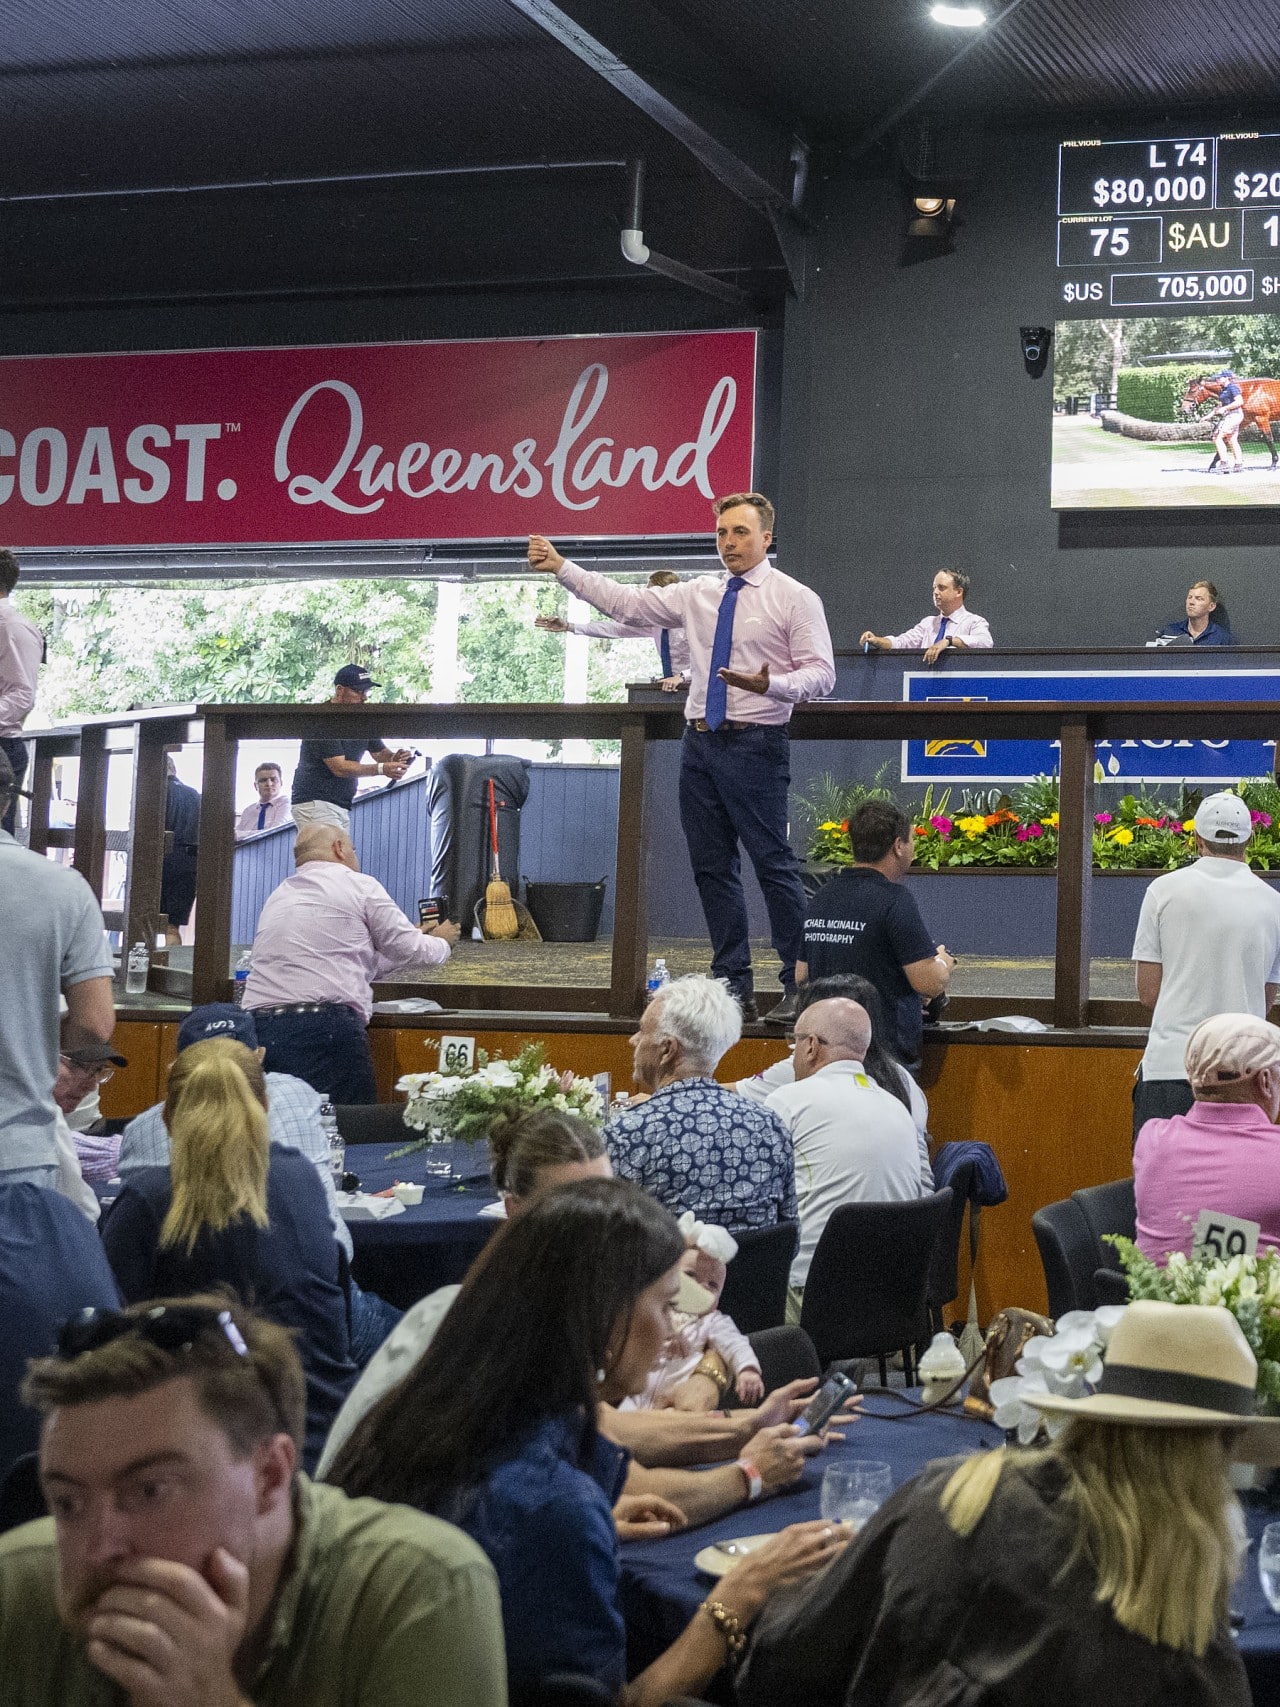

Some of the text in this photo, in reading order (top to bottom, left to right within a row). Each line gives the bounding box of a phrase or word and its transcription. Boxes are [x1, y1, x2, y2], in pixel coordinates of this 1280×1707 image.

[1149, 142, 1207, 168] L 74
[1092, 175, 1206, 208] $80,000
[1089, 227, 1130, 257] 75
[1168, 221, 1231, 252] $AU
[1063, 281, 1103, 302] $US
[1157, 274, 1248, 299] 705,000
[274, 362, 737, 515] Queensland
[804, 932, 855, 944] PHOTOGRAPHY
